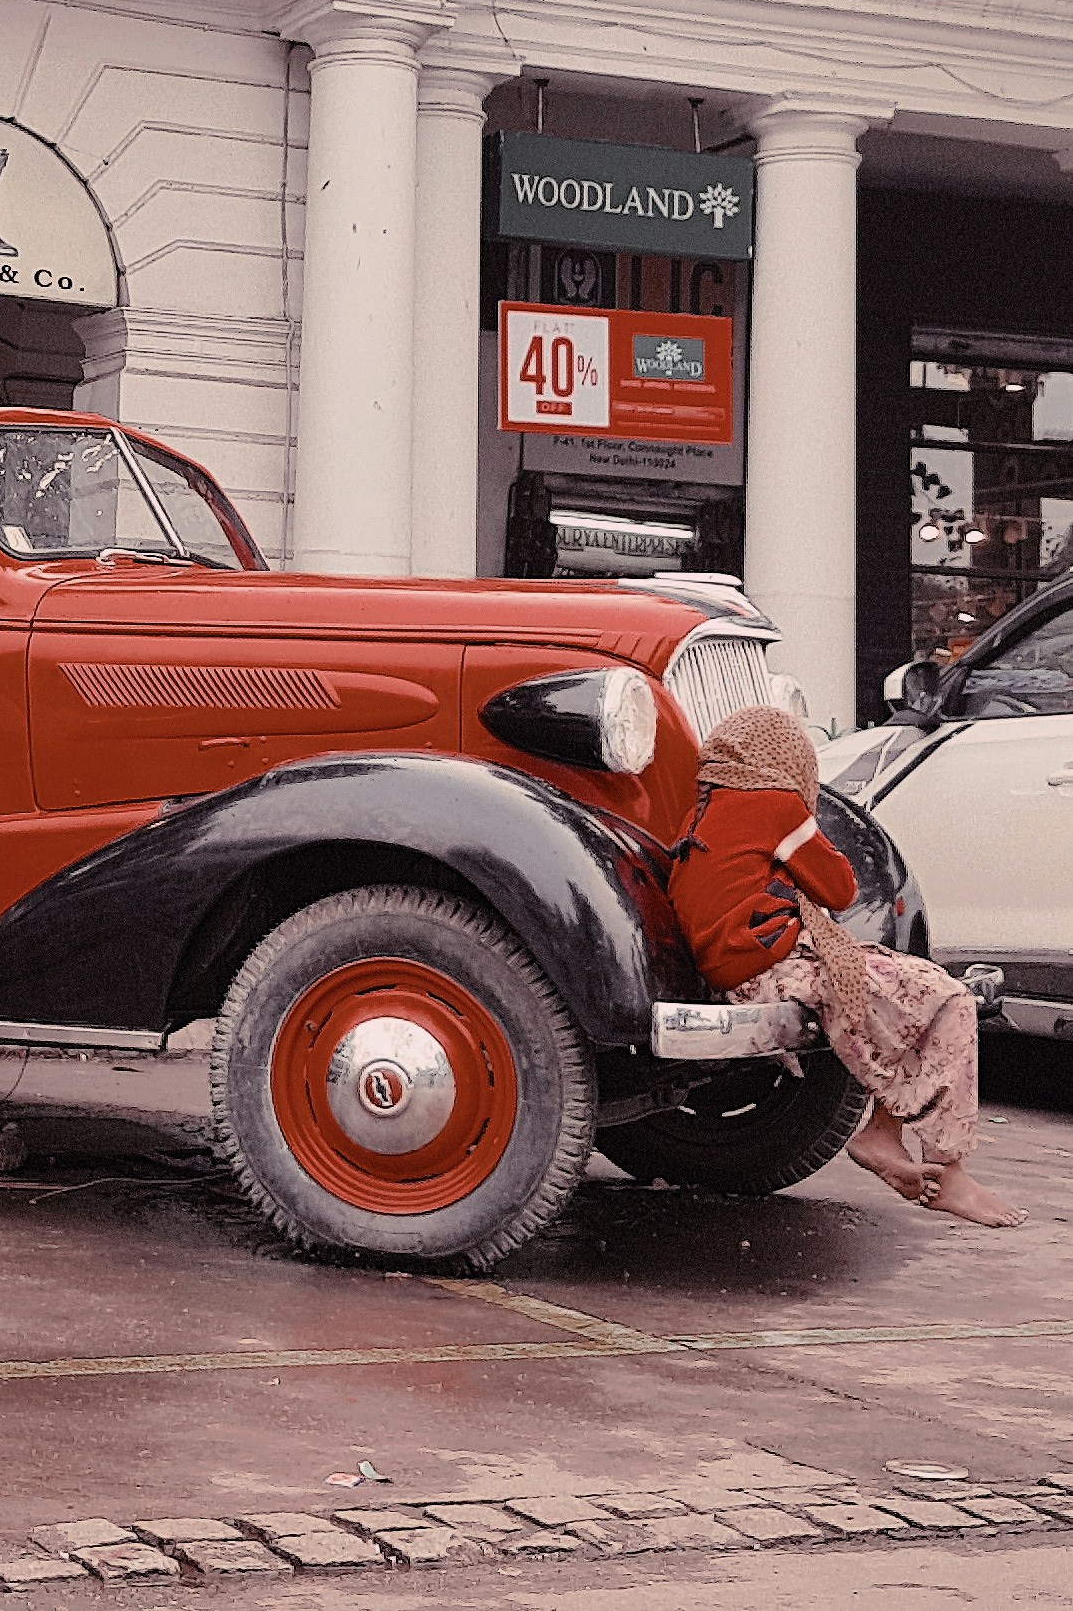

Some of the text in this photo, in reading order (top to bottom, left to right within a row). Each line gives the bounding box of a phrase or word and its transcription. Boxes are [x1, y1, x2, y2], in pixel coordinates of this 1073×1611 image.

[512, 173, 695, 221] WOODLAND
[0, 264, 20, 284] &
[34, 268, 86, 292] Co.
[533, 320, 574, 334] FLAT
[636, 357, 703, 377] WOODLAND
[589, 454, 610, 464] New
[686, 445, 714, 457] Place
